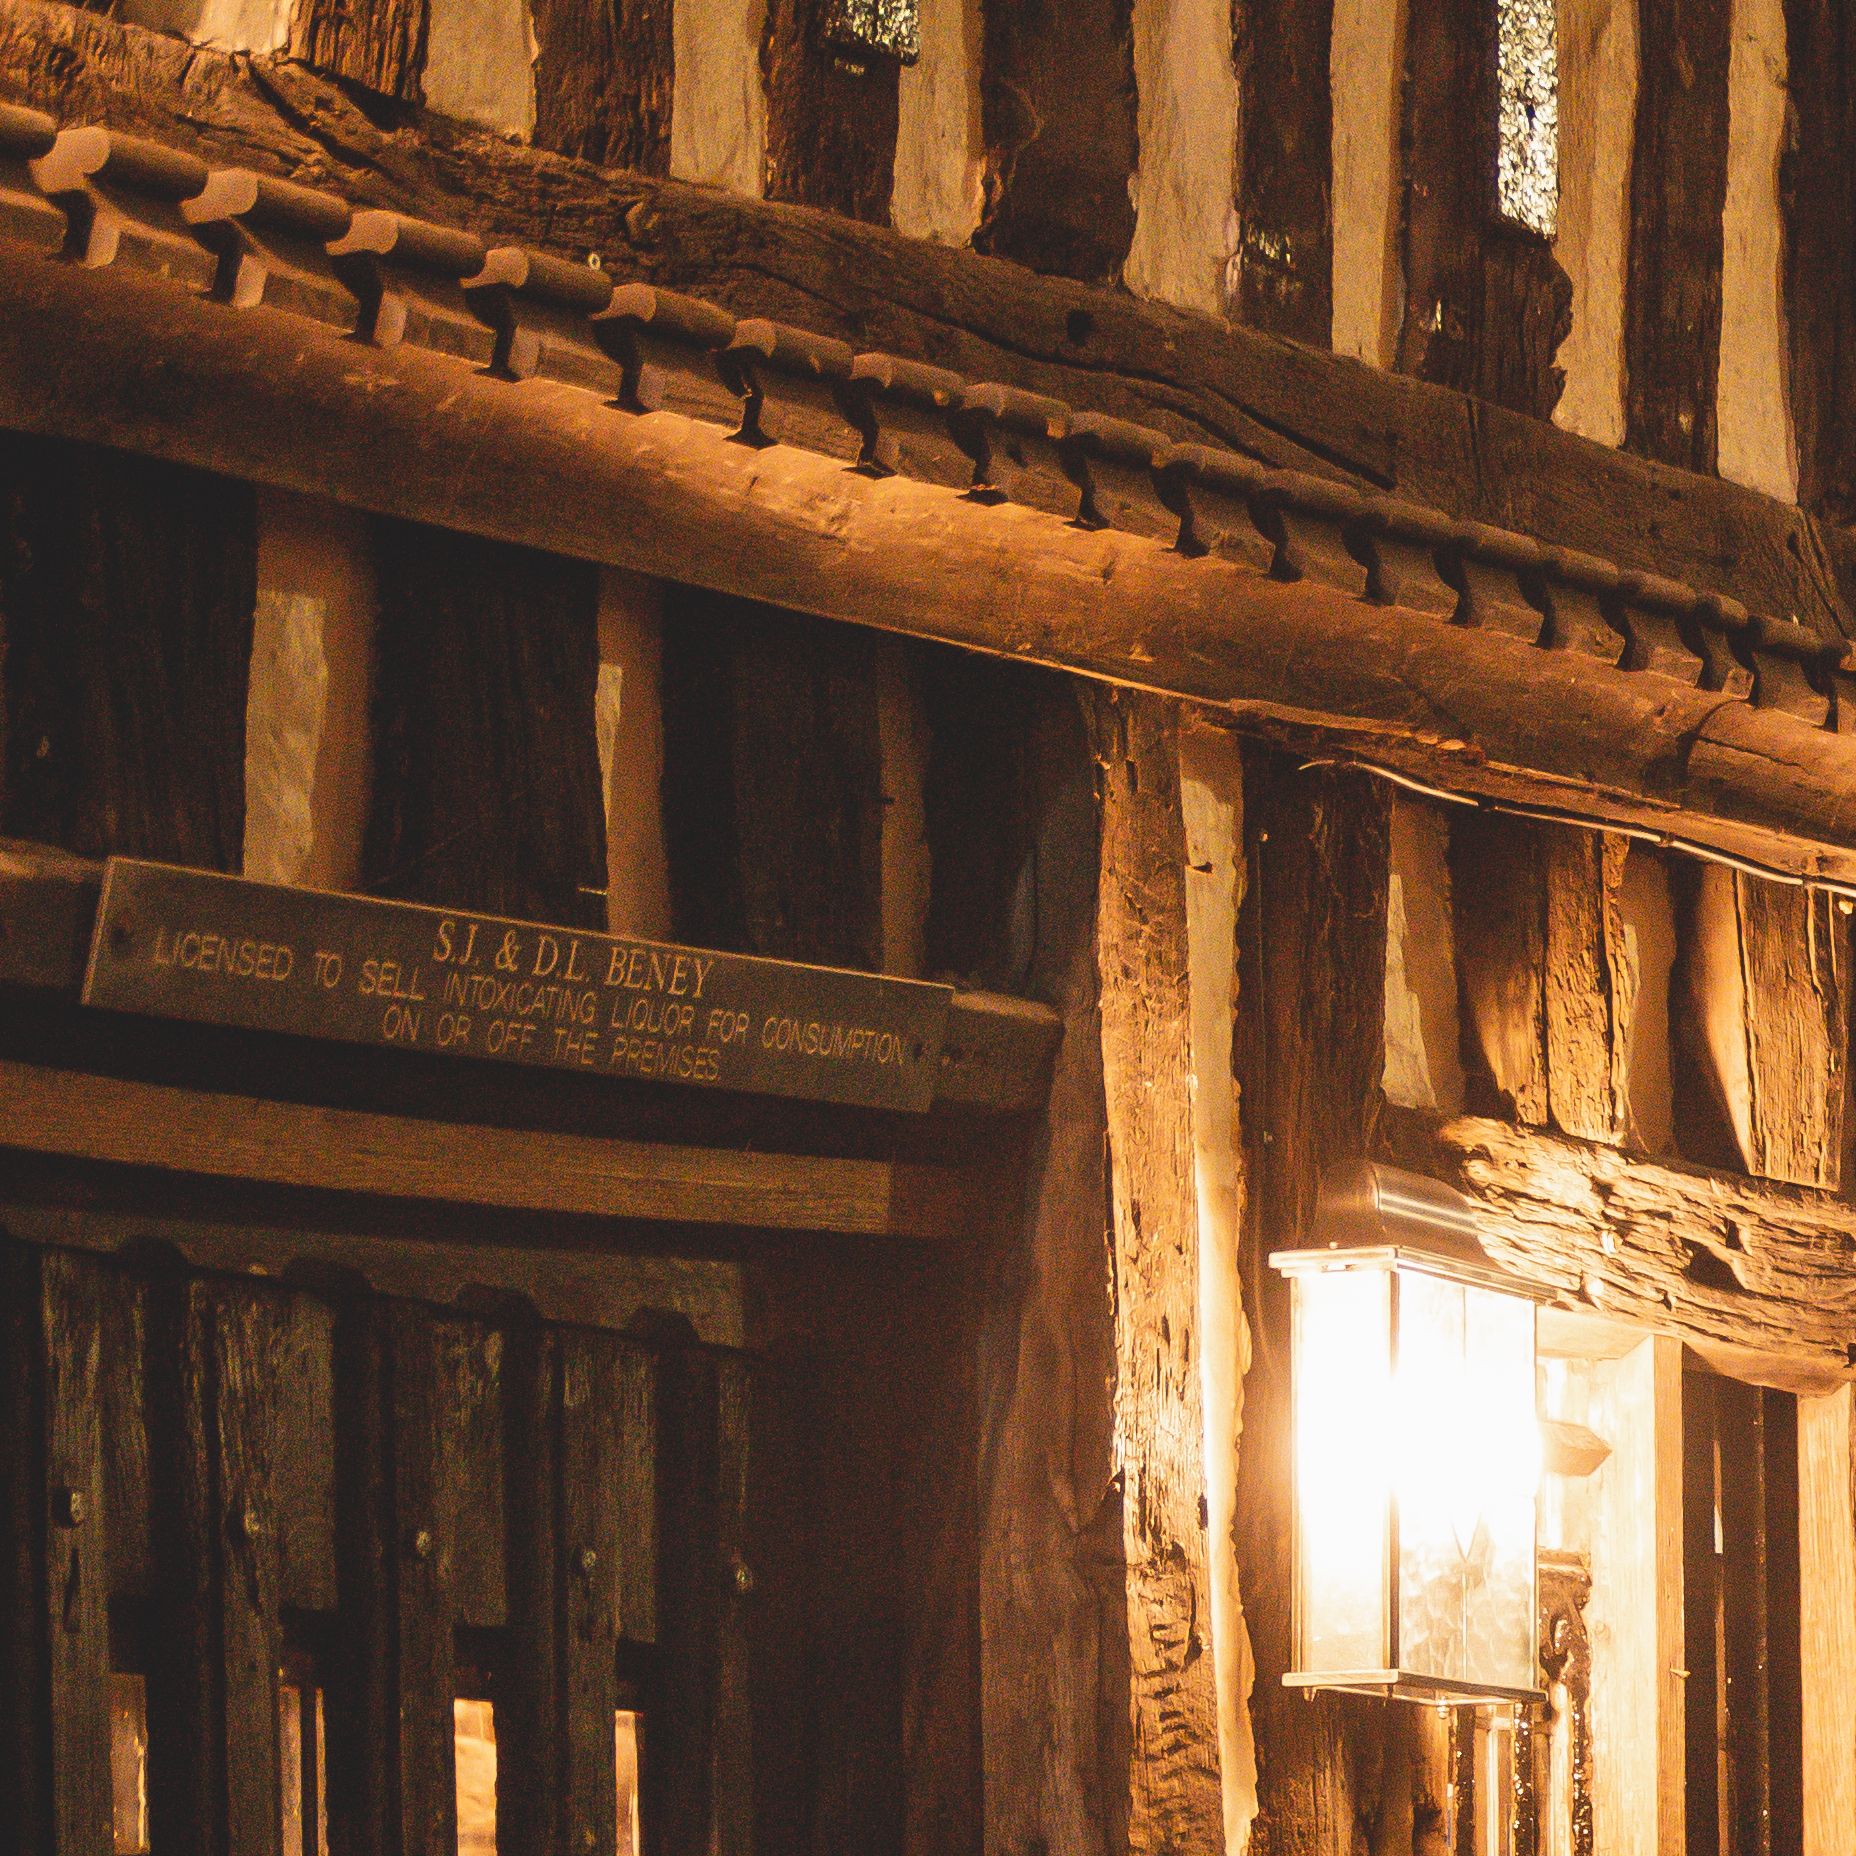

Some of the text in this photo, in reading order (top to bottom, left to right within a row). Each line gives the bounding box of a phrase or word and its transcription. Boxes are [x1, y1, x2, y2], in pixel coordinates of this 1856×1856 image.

[153, 926, 905, 1065] LICENSED TO SELL INTOXICATING LIQUOR FOR CONSUMPTION
[495, 929, 520, 972] &
[605, 946, 716, 998] BENEY
[382, 1004, 720, 1081] ON OR OFF THE PREMISES
